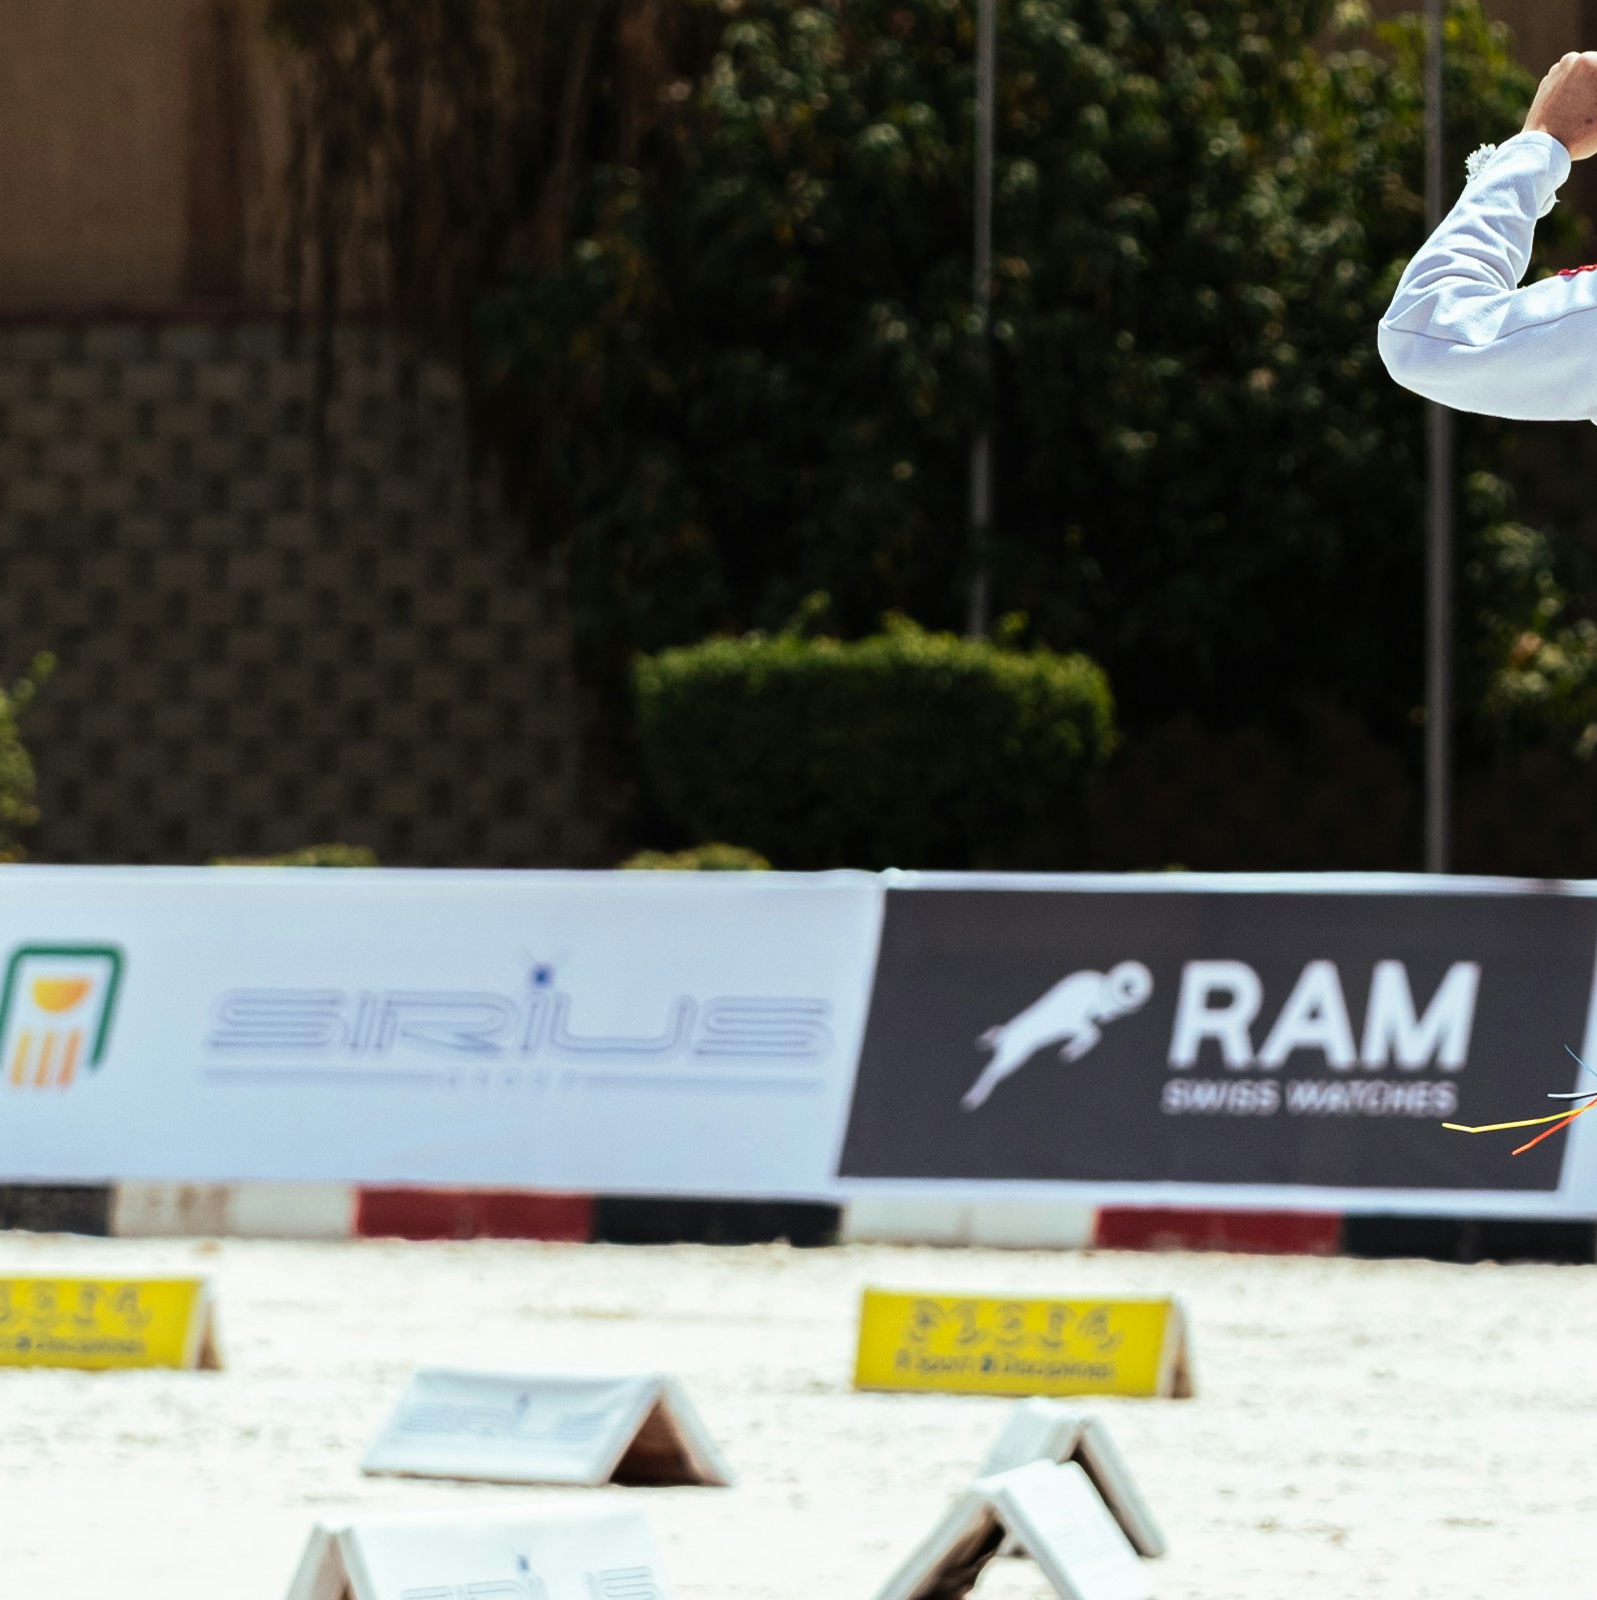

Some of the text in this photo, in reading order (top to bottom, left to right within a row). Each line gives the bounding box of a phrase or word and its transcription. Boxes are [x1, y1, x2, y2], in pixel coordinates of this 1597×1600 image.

[1167, 959, 1482, 1070] RAM
[1161, 1078, 1459, 1119] SWISS WATCHES
